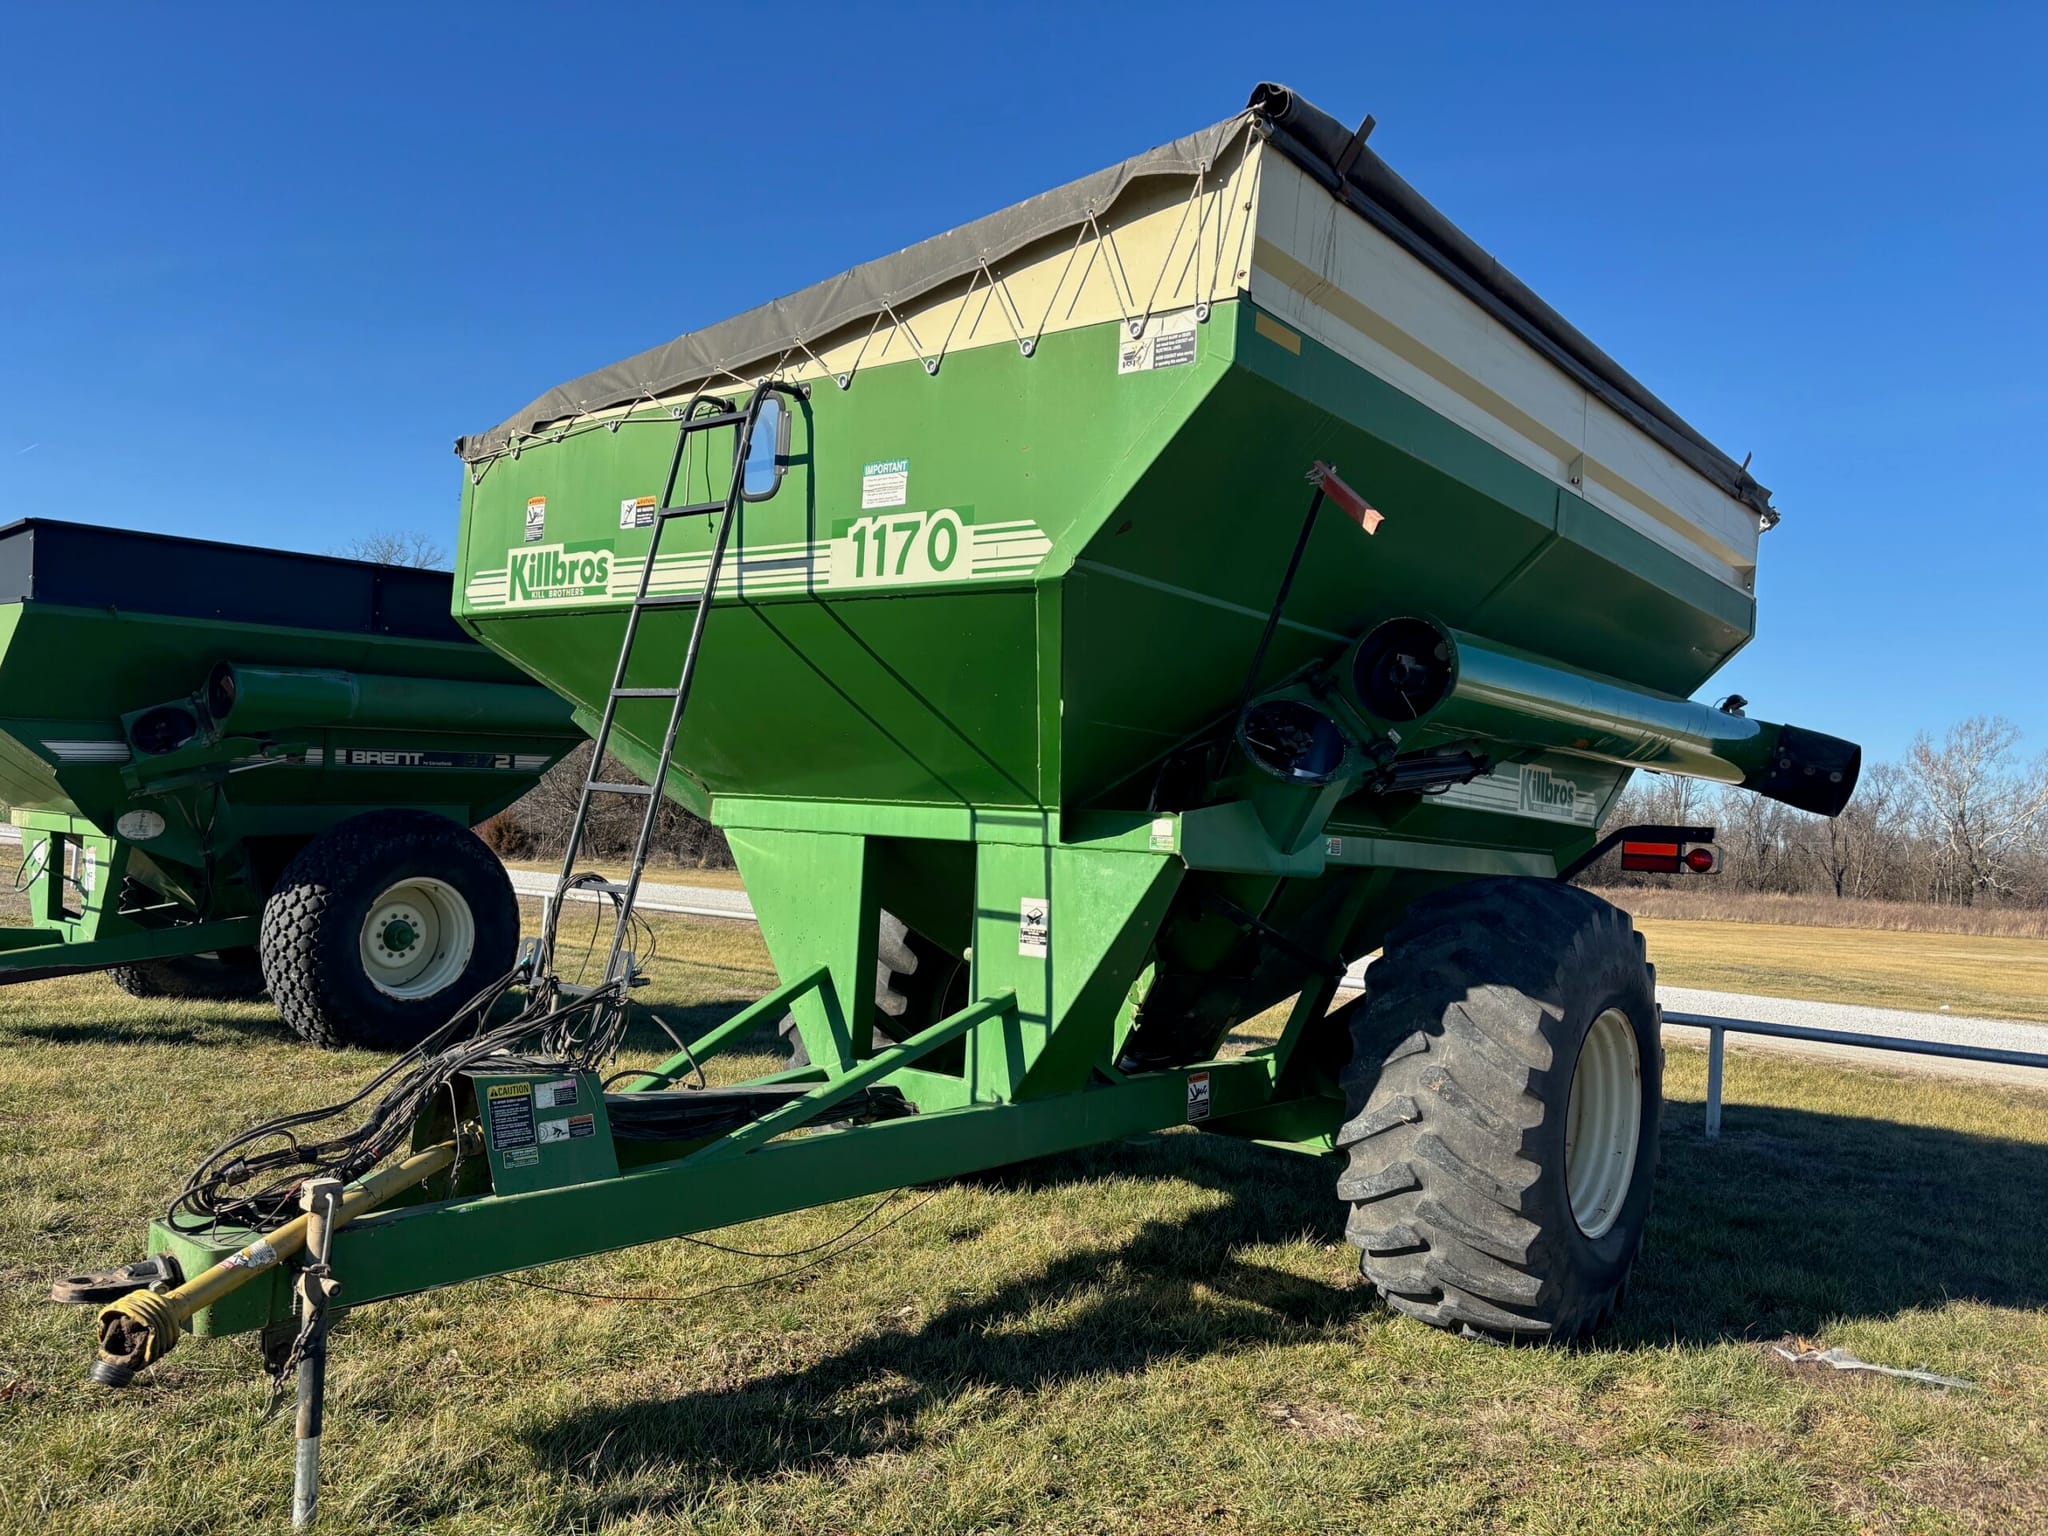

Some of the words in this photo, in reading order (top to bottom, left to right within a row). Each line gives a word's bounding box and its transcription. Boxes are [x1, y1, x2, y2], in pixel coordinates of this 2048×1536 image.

[865, 460, 907, 475] IMPORTANT
[852, 517, 958, 578] 1170
[509, 551, 609, 602] Killbros
[531, 590, 545, 599] KILL
[548, 588, 584, 598] BROTHERS
[352, 750, 424, 765] BRENT
[1520, 767, 1574, 811] Killbros
[497, 1084, 529, 1097] CAUTION
